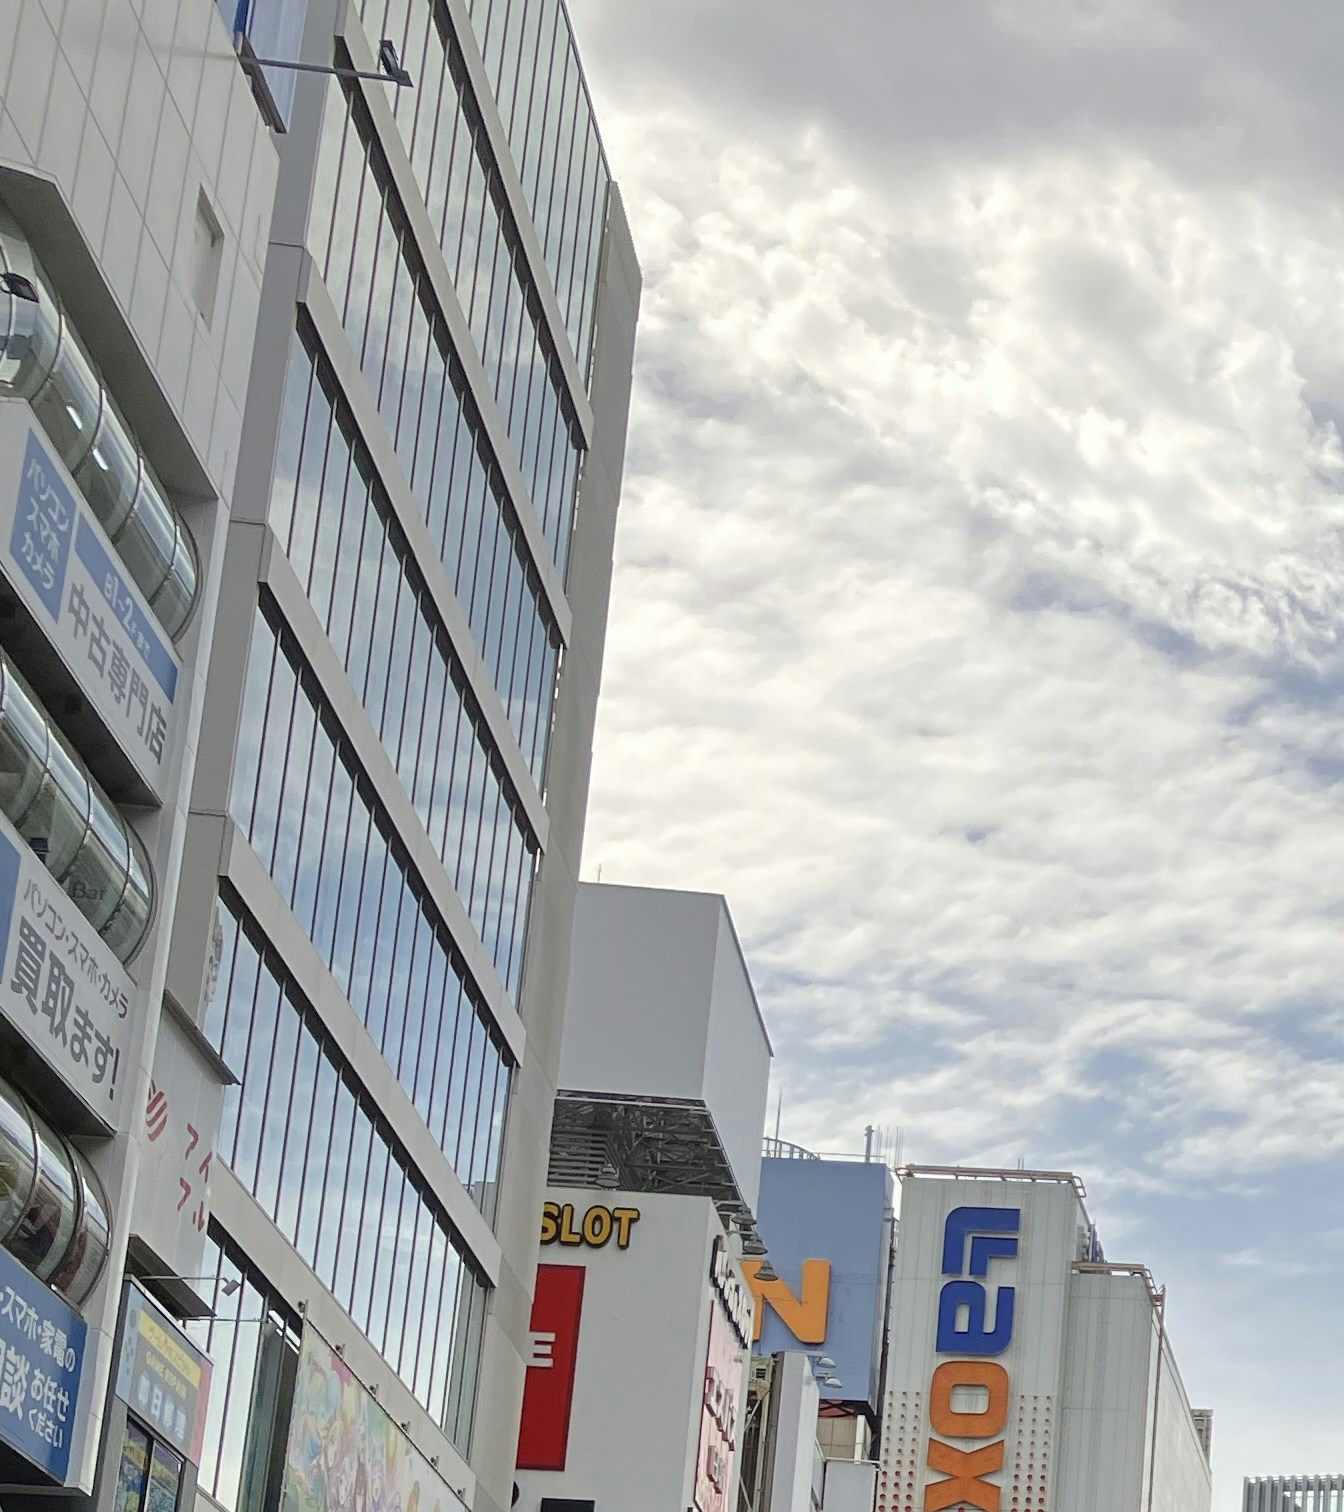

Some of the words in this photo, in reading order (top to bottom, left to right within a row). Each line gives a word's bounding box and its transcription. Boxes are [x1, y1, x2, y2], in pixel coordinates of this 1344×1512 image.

[21, 532, 55, 590] カメラ
[67, 583, 168, 766] 中古専門店
[541, 1201, 641, 1250] SLOT
